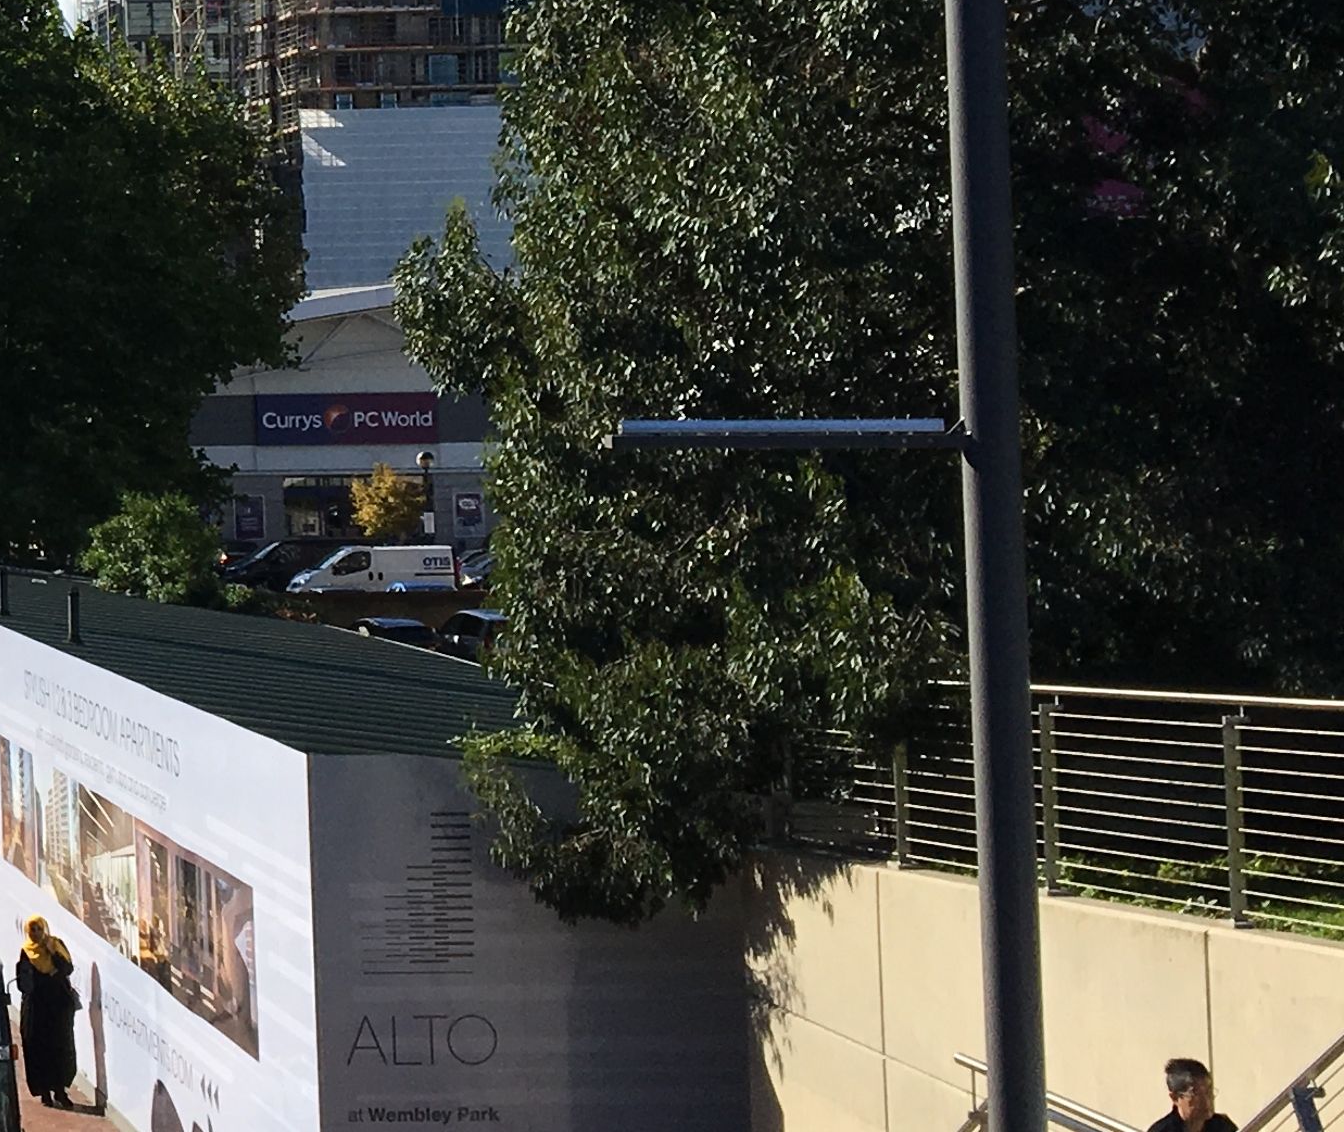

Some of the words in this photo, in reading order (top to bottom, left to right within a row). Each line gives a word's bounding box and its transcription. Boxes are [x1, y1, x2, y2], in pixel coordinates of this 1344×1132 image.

[262, 412, 322, 431] Currys
[354, 411, 379, 428] PC
[380, 410, 433, 428] World
[423, 556, 450, 566] OTIS
[119, 713, 181, 778] APARTMENTS
[347, 1014, 498, 1066] ALTO
[348, 1109, 364, 1122] at
[368, 1106, 451, 1125] Wembley
[457, 1106, 500, 1122] Park
